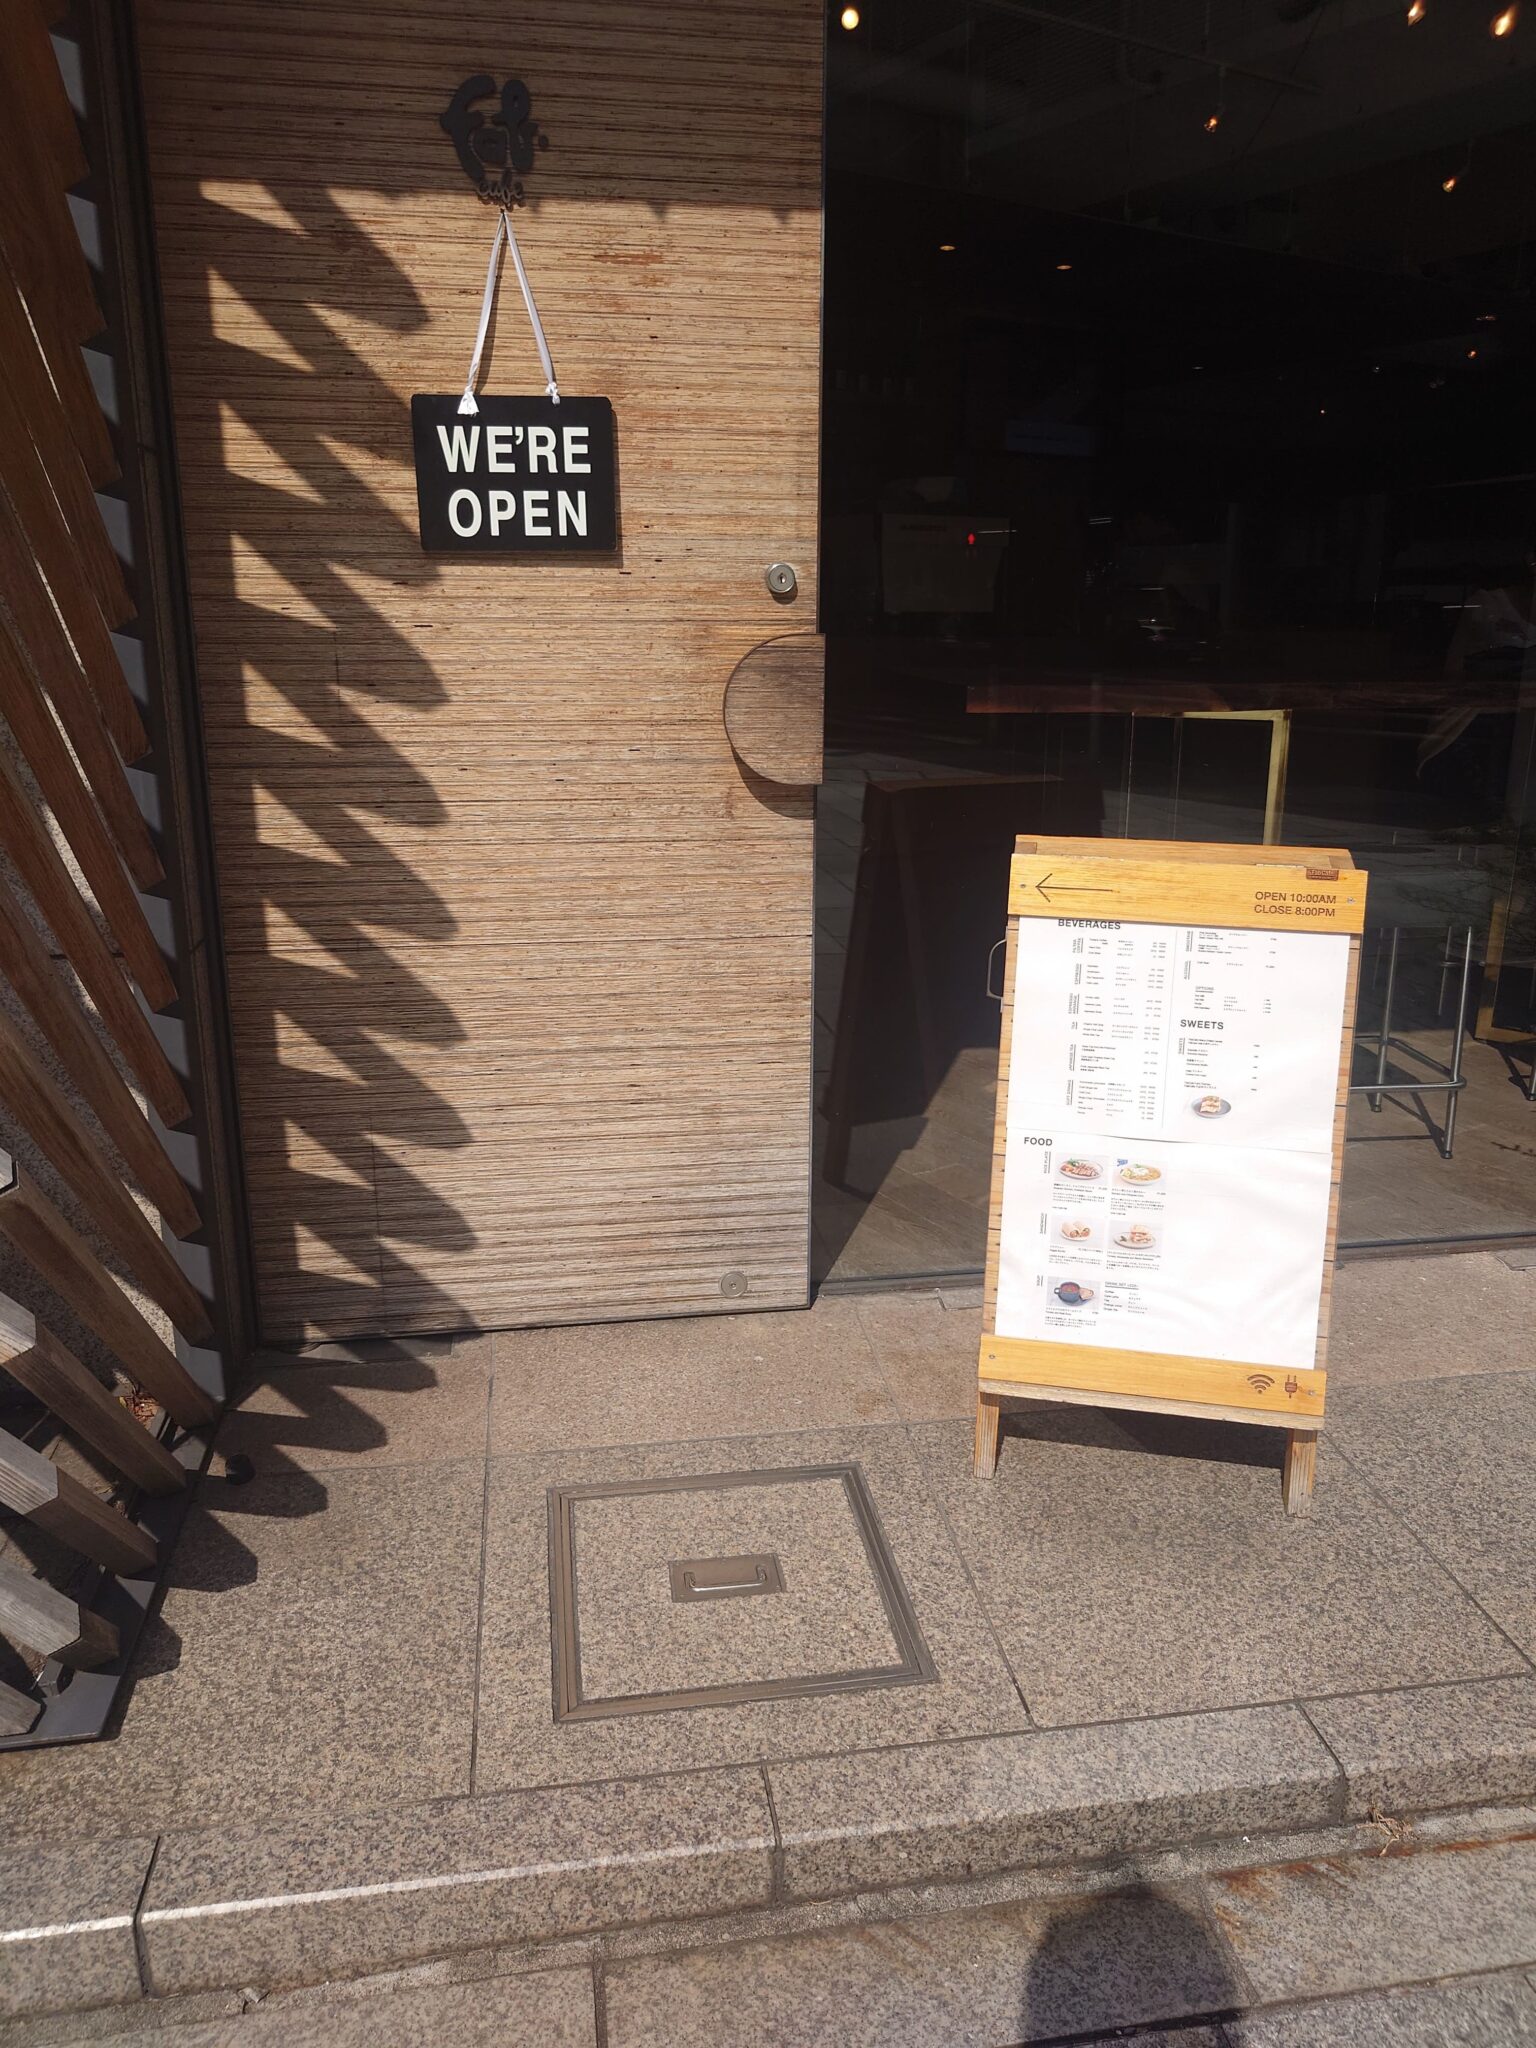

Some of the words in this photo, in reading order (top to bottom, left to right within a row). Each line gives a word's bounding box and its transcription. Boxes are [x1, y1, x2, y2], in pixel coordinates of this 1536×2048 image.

[436, 425, 592, 474] WE'RE
[448, 488, 588, 537] OPEN
[1254, 890, 1287, 902] OPEN
[1289, 893, 1337, 904] 10:00AM
[1253, 904, 1292, 915] CLOSE
[1294, 906, 1336, 917] 8:00PM
[1057, 918, 1122, 931] BEVERAGES
[1179, 1018, 1225, 1031] SWEETS
[1023, 1136, 1053, 1147] FOOD
